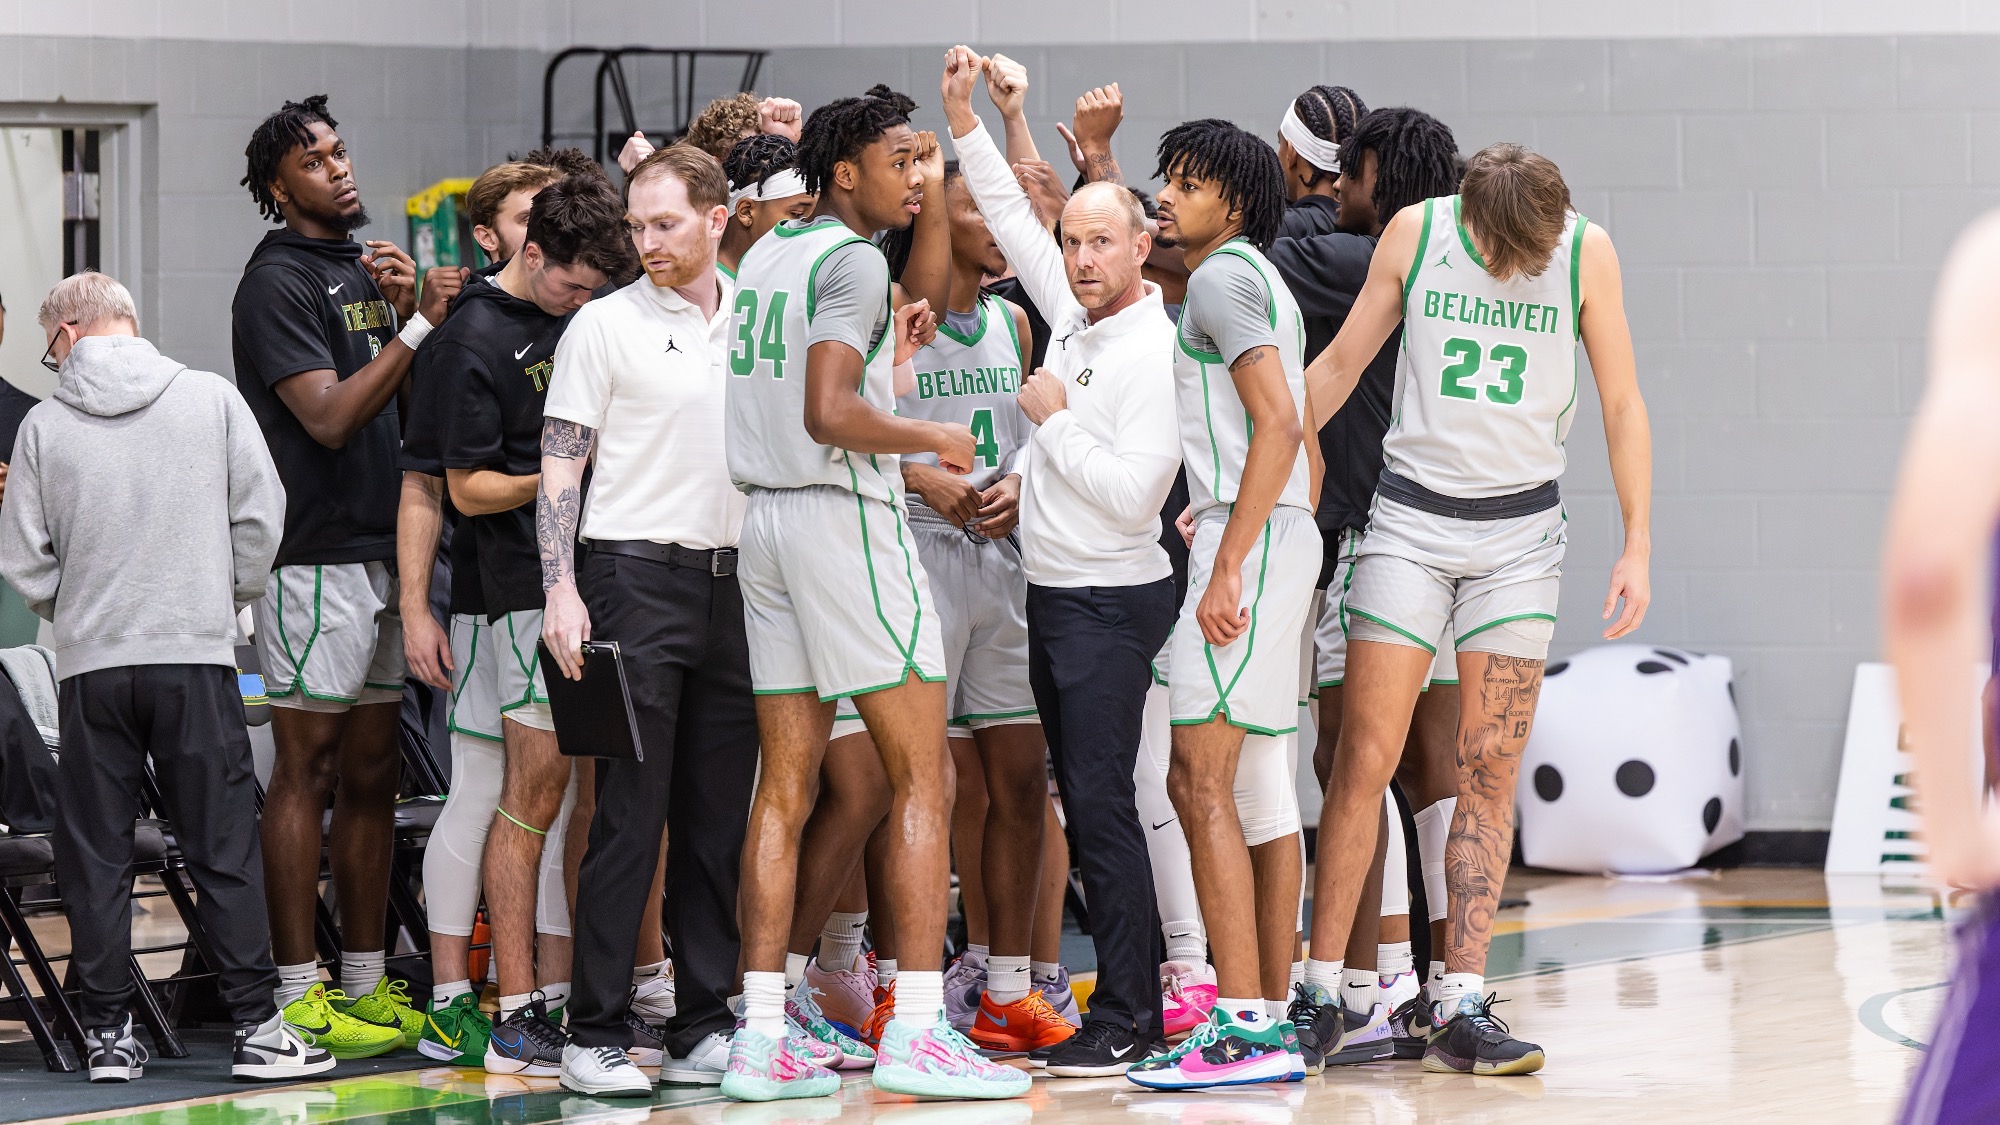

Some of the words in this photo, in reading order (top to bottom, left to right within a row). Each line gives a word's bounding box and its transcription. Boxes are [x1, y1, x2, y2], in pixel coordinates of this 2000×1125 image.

[729, 287, 790, 379] 34
[1439, 336, 1529, 406] 23
[1494, 685, 1511, 701] 14
[1512, 720, 1527, 739] 13
